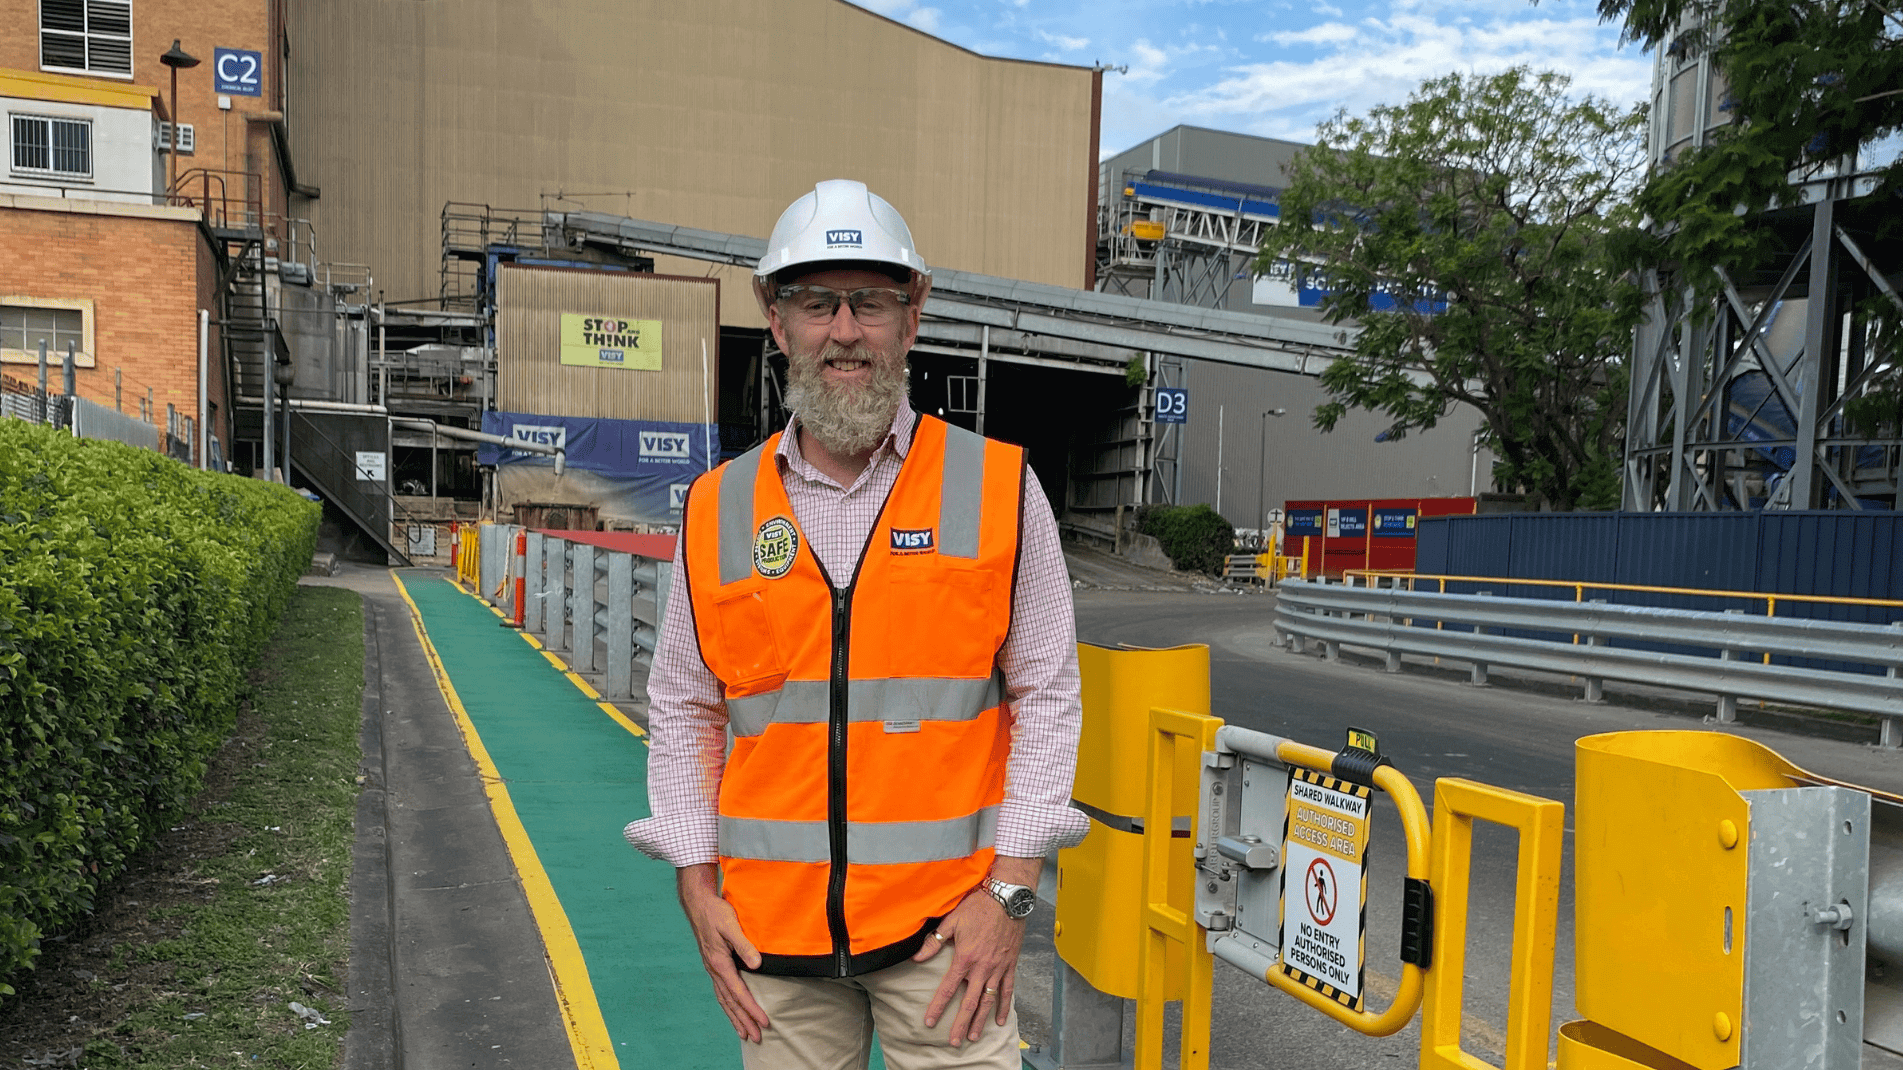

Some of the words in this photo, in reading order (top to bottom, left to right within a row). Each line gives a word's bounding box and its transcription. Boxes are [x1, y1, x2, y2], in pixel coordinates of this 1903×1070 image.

[217, 53, 258, 84] C2
[828, 231, 860, 242] VISY
[583, 318, 629, 333] STOP
[600, 350, 623, 360] VISY
[1157, 391, 1186, 414] D3
[517, 430, 561, 446] VISY
[643, 437, 686, 452] VISY
[766, 529, 783, 539] VISY
[892, 531, 931, 547] VISY
[760, 537, 789, 559] SAFE
[1294, 784, 1323, 801] SHARED
[1324, 793, 1362, 814] WALKWAY
[1296, 807, 1356, 837] AUTHORISED
[1293, 824, 1328, 847] ACCESS
[1329, 836, 1356, 856] AREA
[1300, 922, 1312, 937] NO
[1314, 928, 1340, 950] ENTRY
[1294, 935, 1346, 968] AUTHORISED
[1290, 947, 1327, 974] PERSONS
[1328, 965, 1350, 985] ONLY
